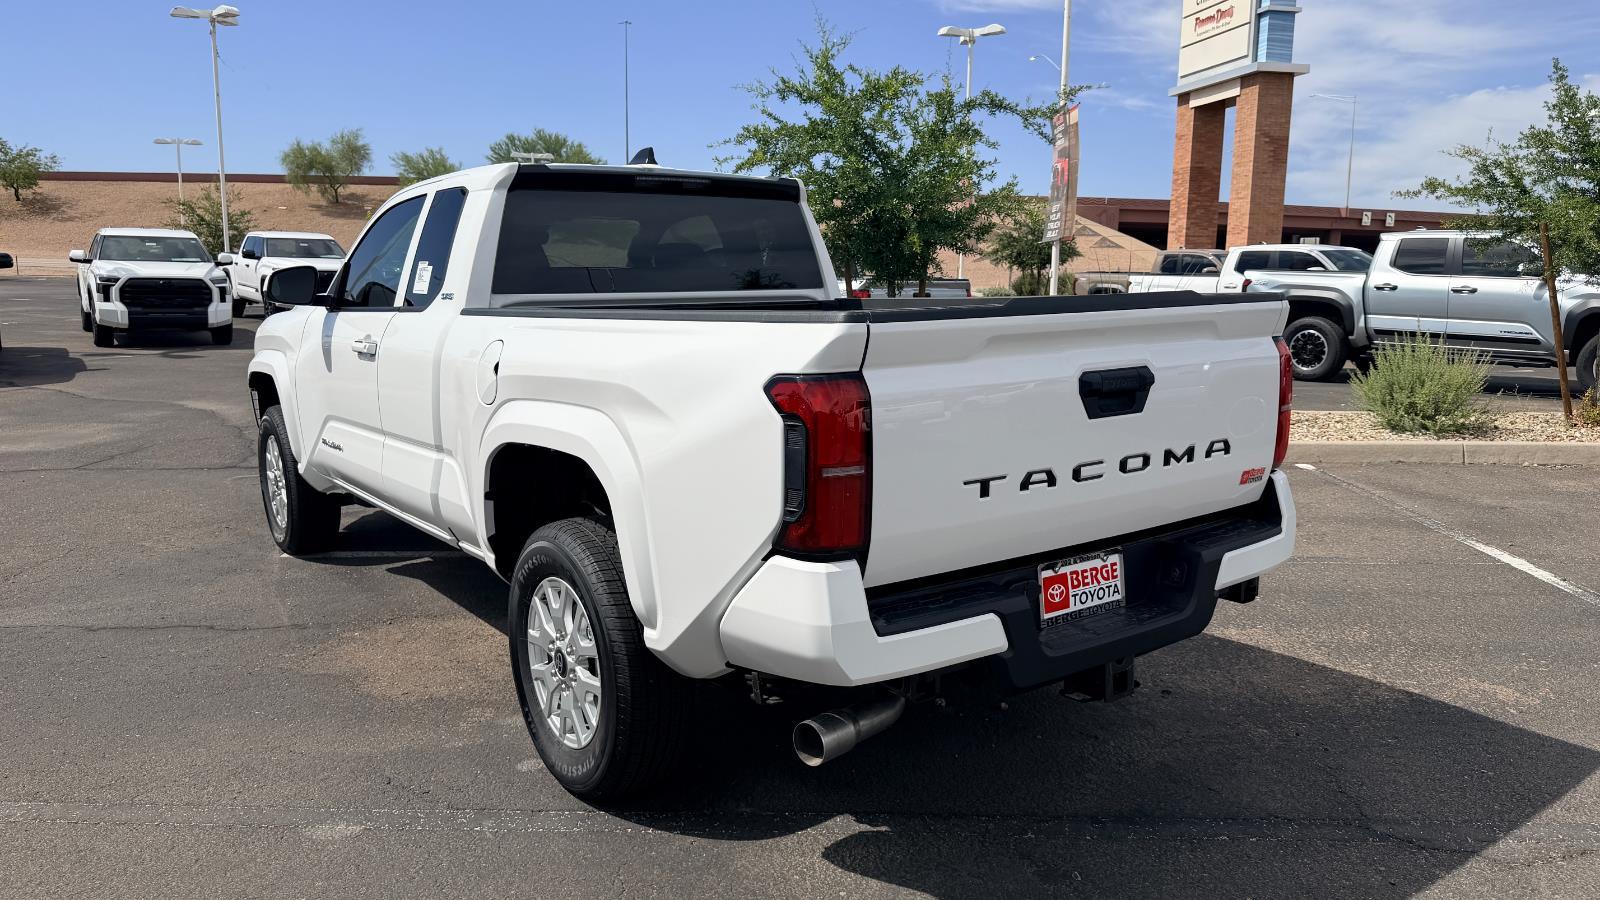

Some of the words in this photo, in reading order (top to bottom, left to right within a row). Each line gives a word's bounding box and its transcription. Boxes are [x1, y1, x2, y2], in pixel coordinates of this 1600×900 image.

[962, 438, 1232, 499] TACOMA
[1069, 561, 1119, 590] BERGE
[1071, 583, 1121, 607] TOYOTA
[1046, 609, 1084, 626] BERGE
[1087, 600, 1121, 615] TOYOTA
